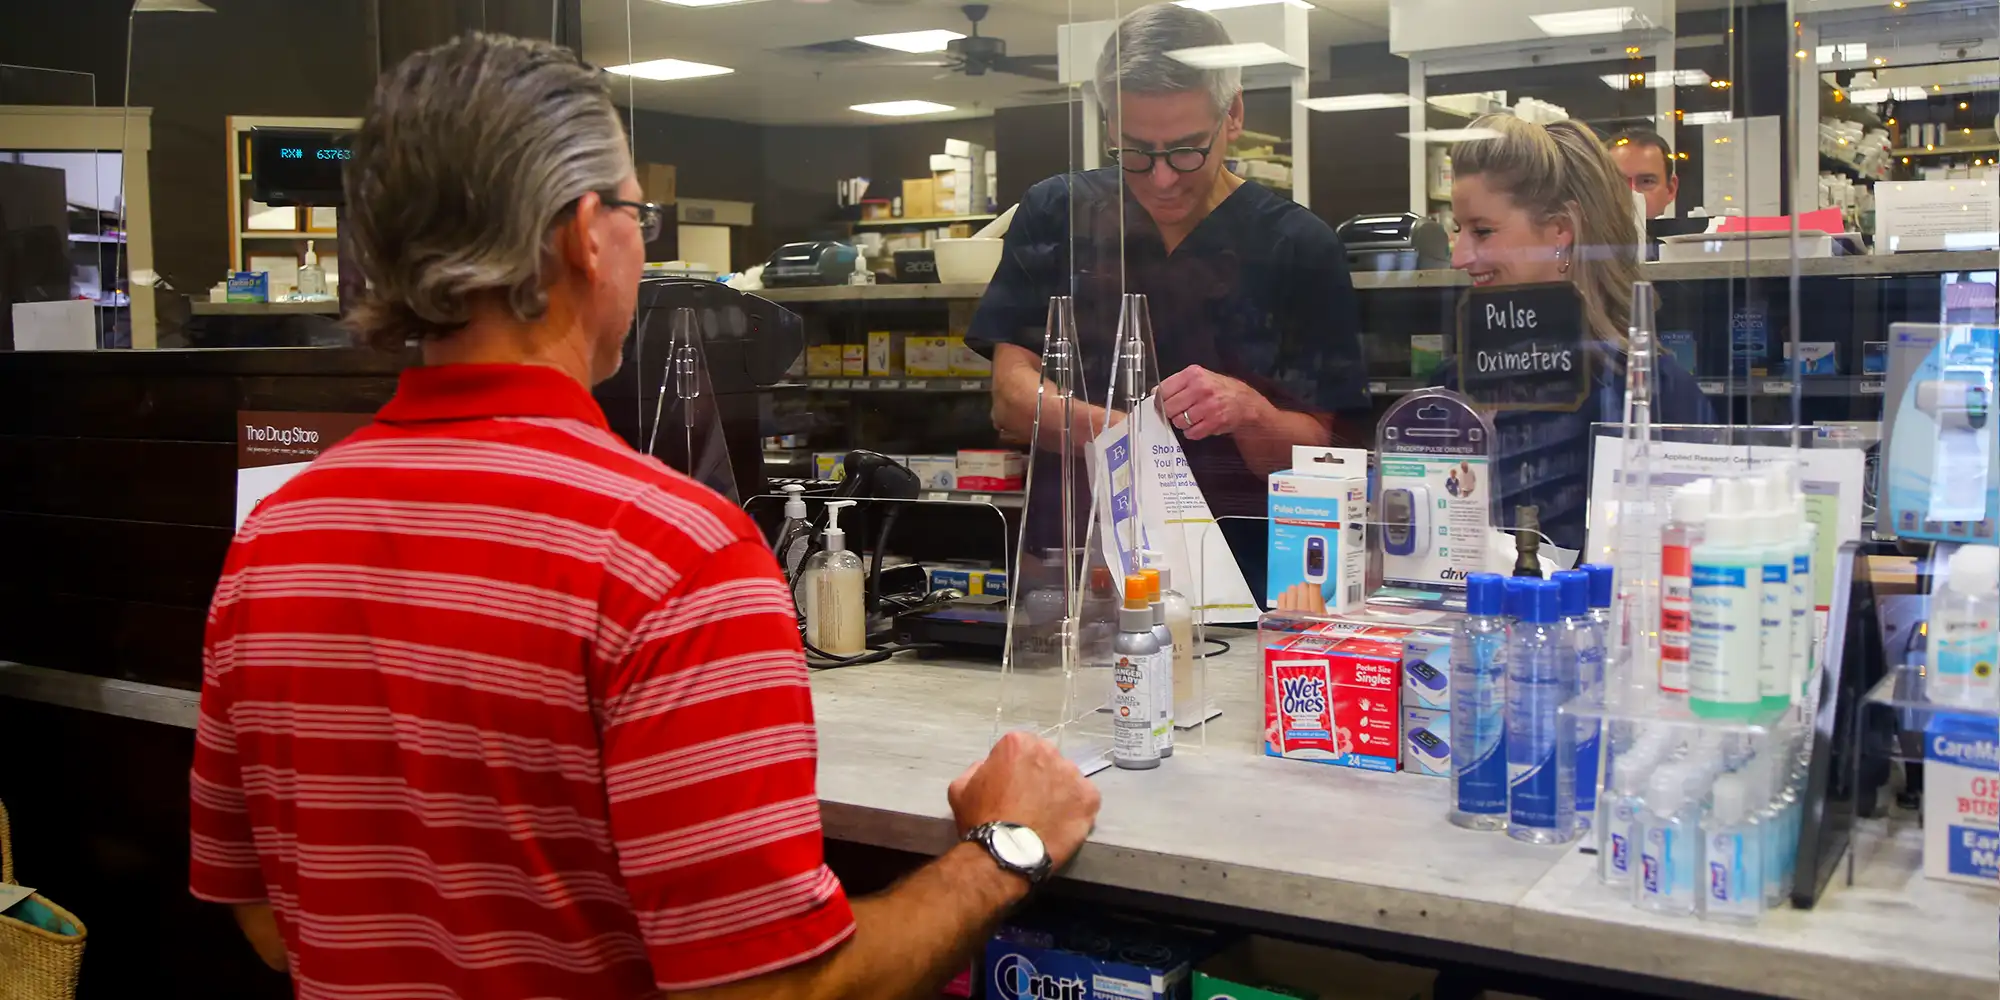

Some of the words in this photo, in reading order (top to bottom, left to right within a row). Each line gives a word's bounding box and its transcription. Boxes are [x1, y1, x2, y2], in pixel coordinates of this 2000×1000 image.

[281, 148, 302, 158] RX#
[316, 149, 353, 160] 63763
[1486, 300, 1538, 330] Pulse
[1477, 342, 1572, 372] Oximeters
[246, 425, 266, 441] The
[266, 426, 292, 446] Drug
[292, 427, 319, 443] Store
[1154, 459, 1172, 468] You
[1663, 452, 1693, 462] Applied
[1273, 503, 1294, 514] Pulse
[1294, 505, 1330, 517] Oximeter
[1440, 567, 1467, 580] driv
[934, 576, 949, 586] Easy
[950, 577, 968, 588] Touch
[1356, 663, 1376, 673] Pocket
[1378, 665, 1392, 674] Size
[1355, 671, 1391, 686] Singles
[1284, 676, 1322, 699] Wet
[1284, 696, 1324, 714] Ones
[1348, 755, 1360, 766] 24
[994, 953, 1087, 1000] Orbit
